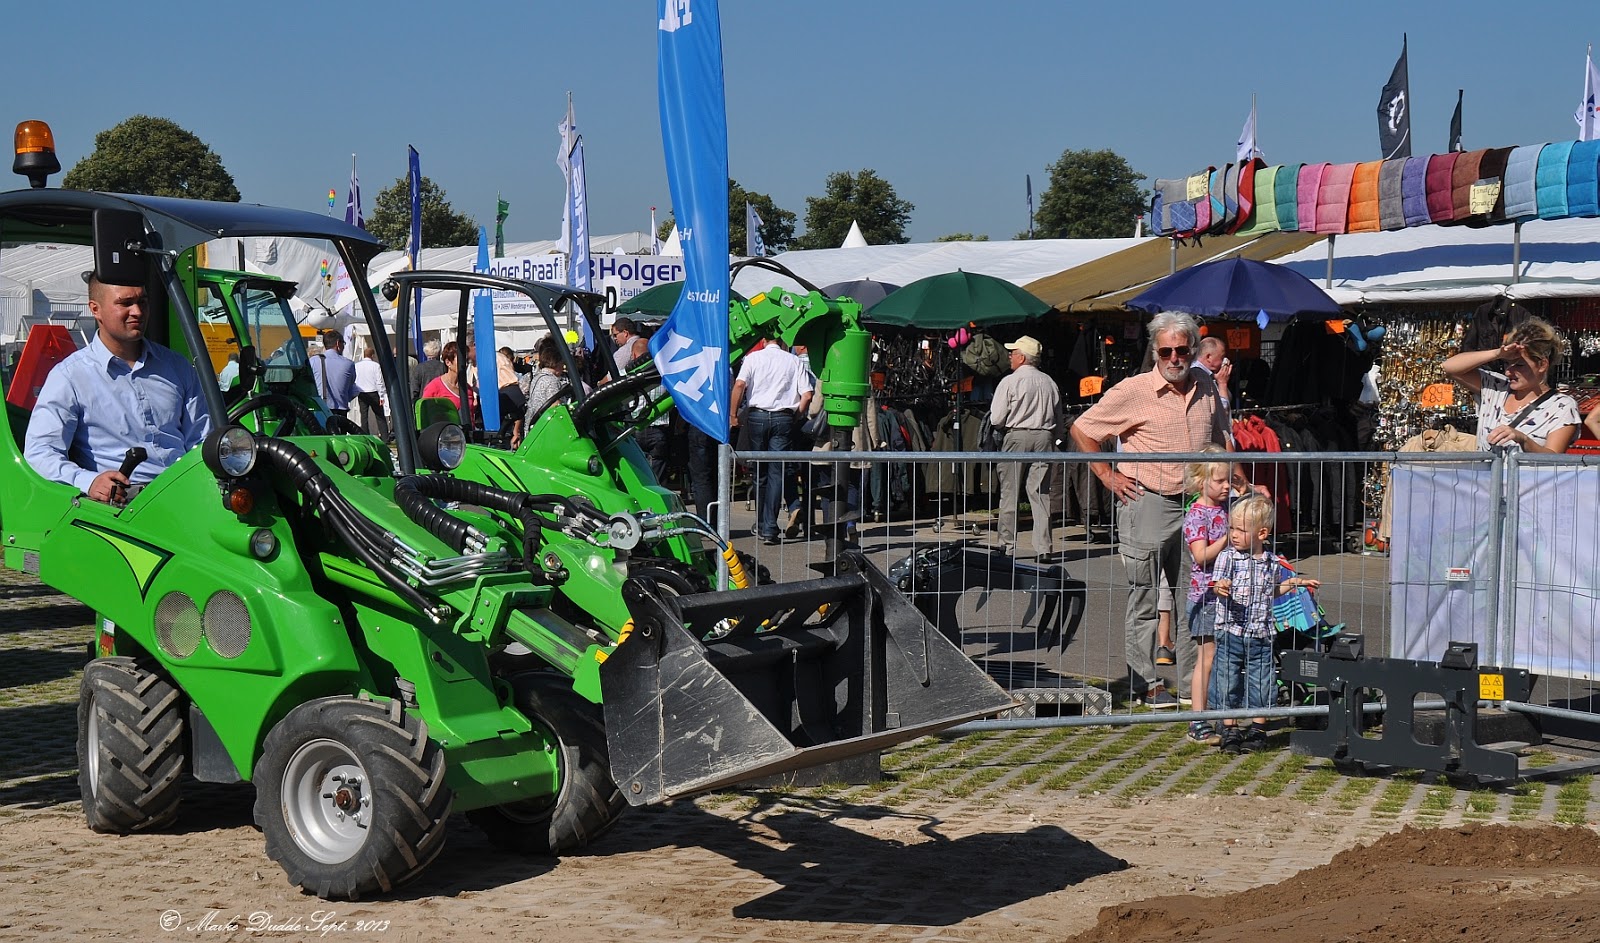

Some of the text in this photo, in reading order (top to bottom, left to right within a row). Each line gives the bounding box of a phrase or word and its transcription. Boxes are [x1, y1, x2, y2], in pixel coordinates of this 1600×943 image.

[523, 257, 559, 280] Braaf
[599, 258, 682, 287] Holger
[605, 286, 618, 314] D
